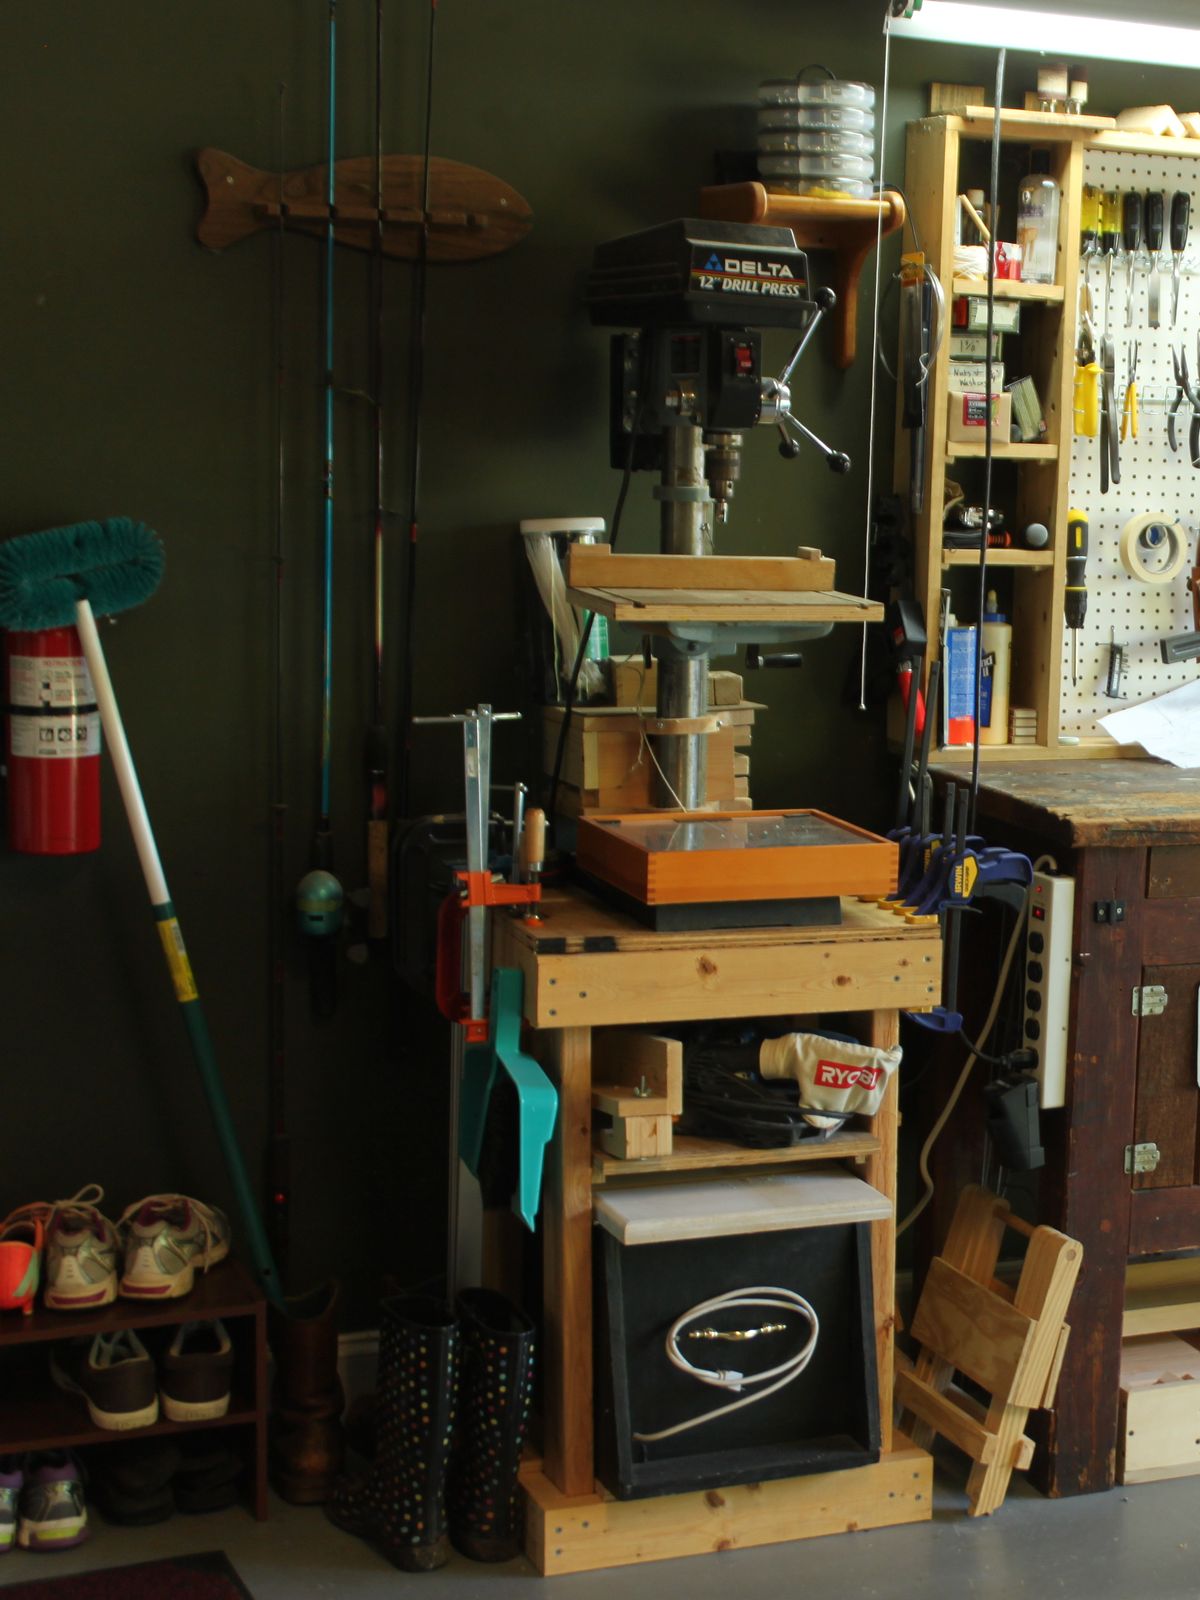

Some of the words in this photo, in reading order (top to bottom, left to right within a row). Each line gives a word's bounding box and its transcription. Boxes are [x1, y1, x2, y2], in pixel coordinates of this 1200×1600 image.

[725, 258, 794, 278] DELTA
[698, 275, 721, 290] 12"
[721, 277, 759, 293] DRILL
[760, 281, 801, 297] PRESS
[954, 865, 962, 893] IRWIN
[821, 1065, 877, 1087] RYOBI
